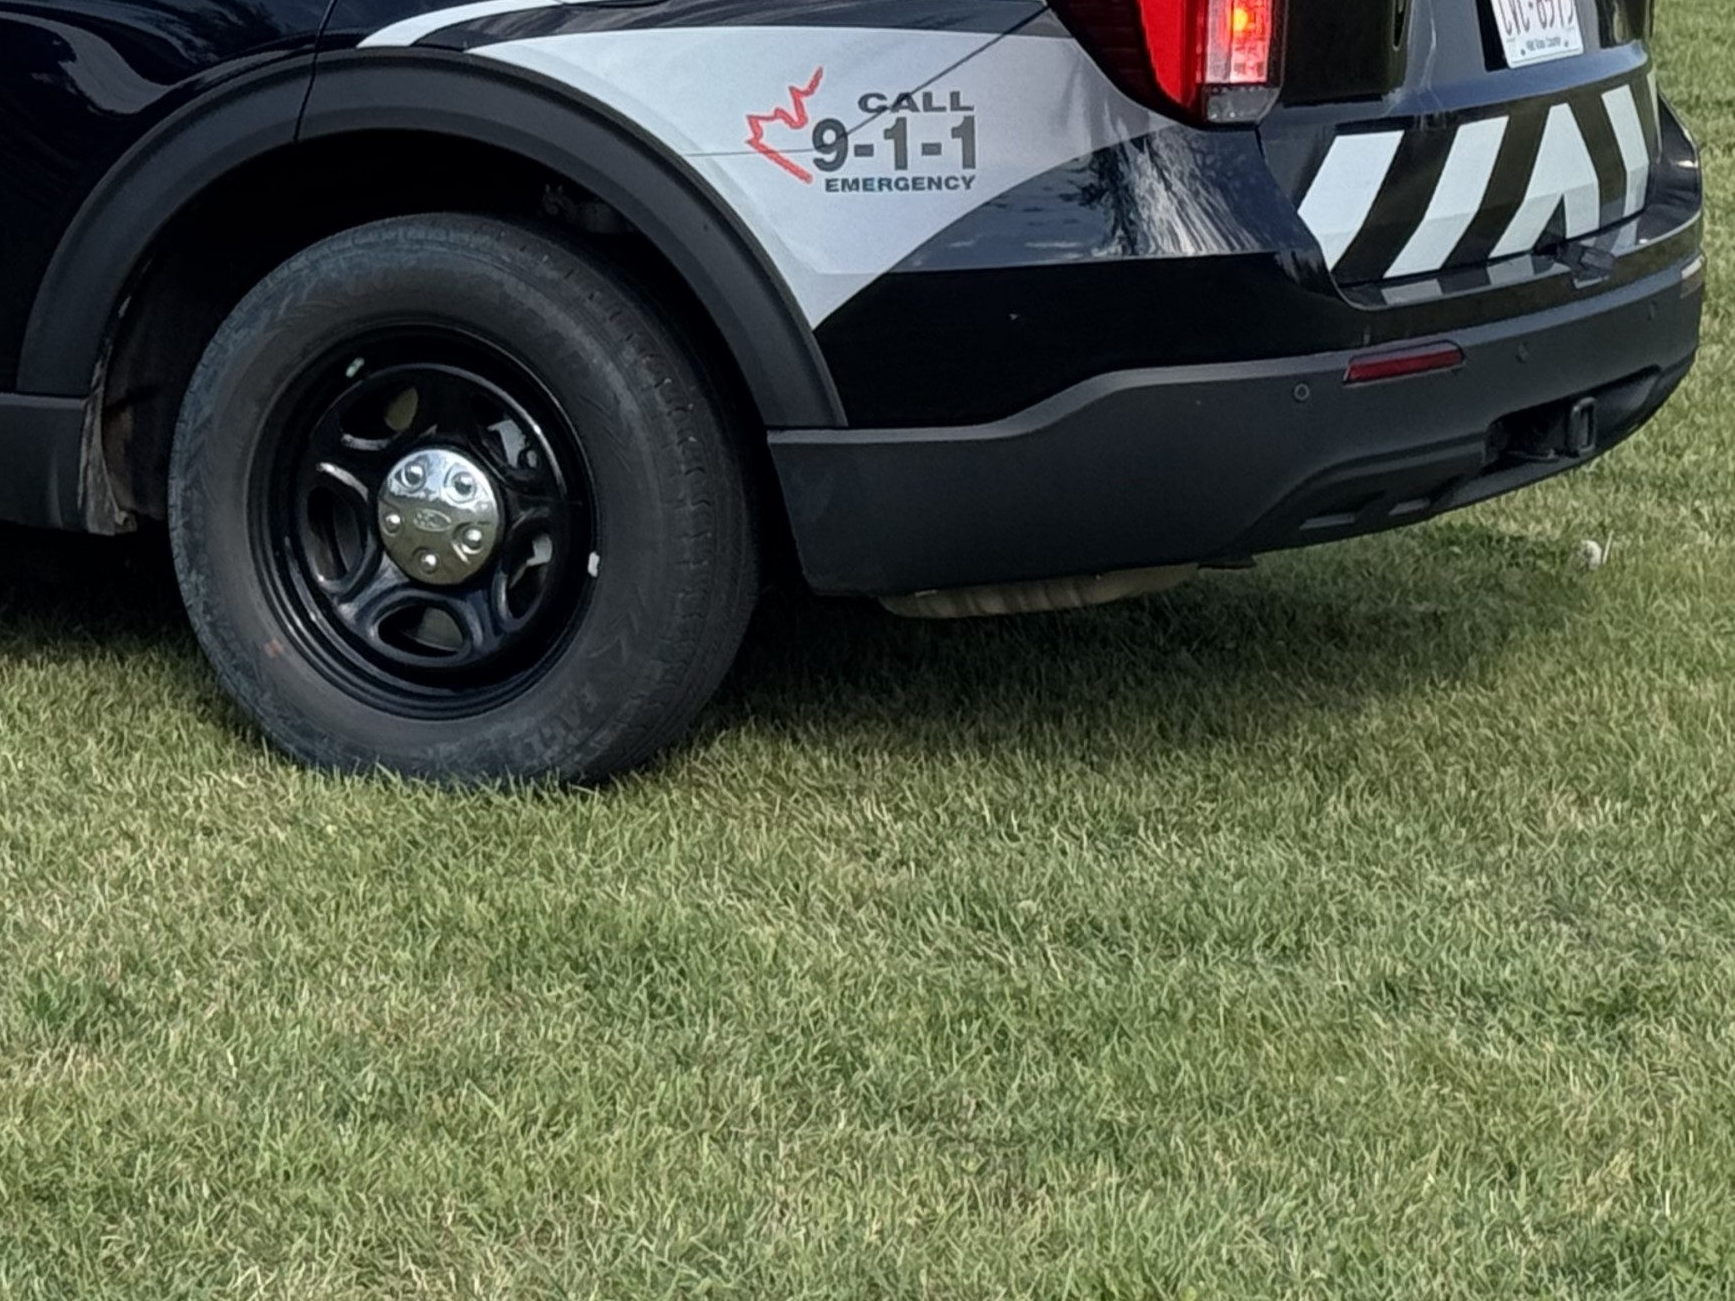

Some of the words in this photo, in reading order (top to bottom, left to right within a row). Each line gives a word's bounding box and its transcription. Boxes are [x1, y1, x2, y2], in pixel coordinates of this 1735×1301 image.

[858, 91, 974, 114] CALL
[812, 116, 976, 173] 9-1-1
[825, 175, 976, 192] EMERGENCY
